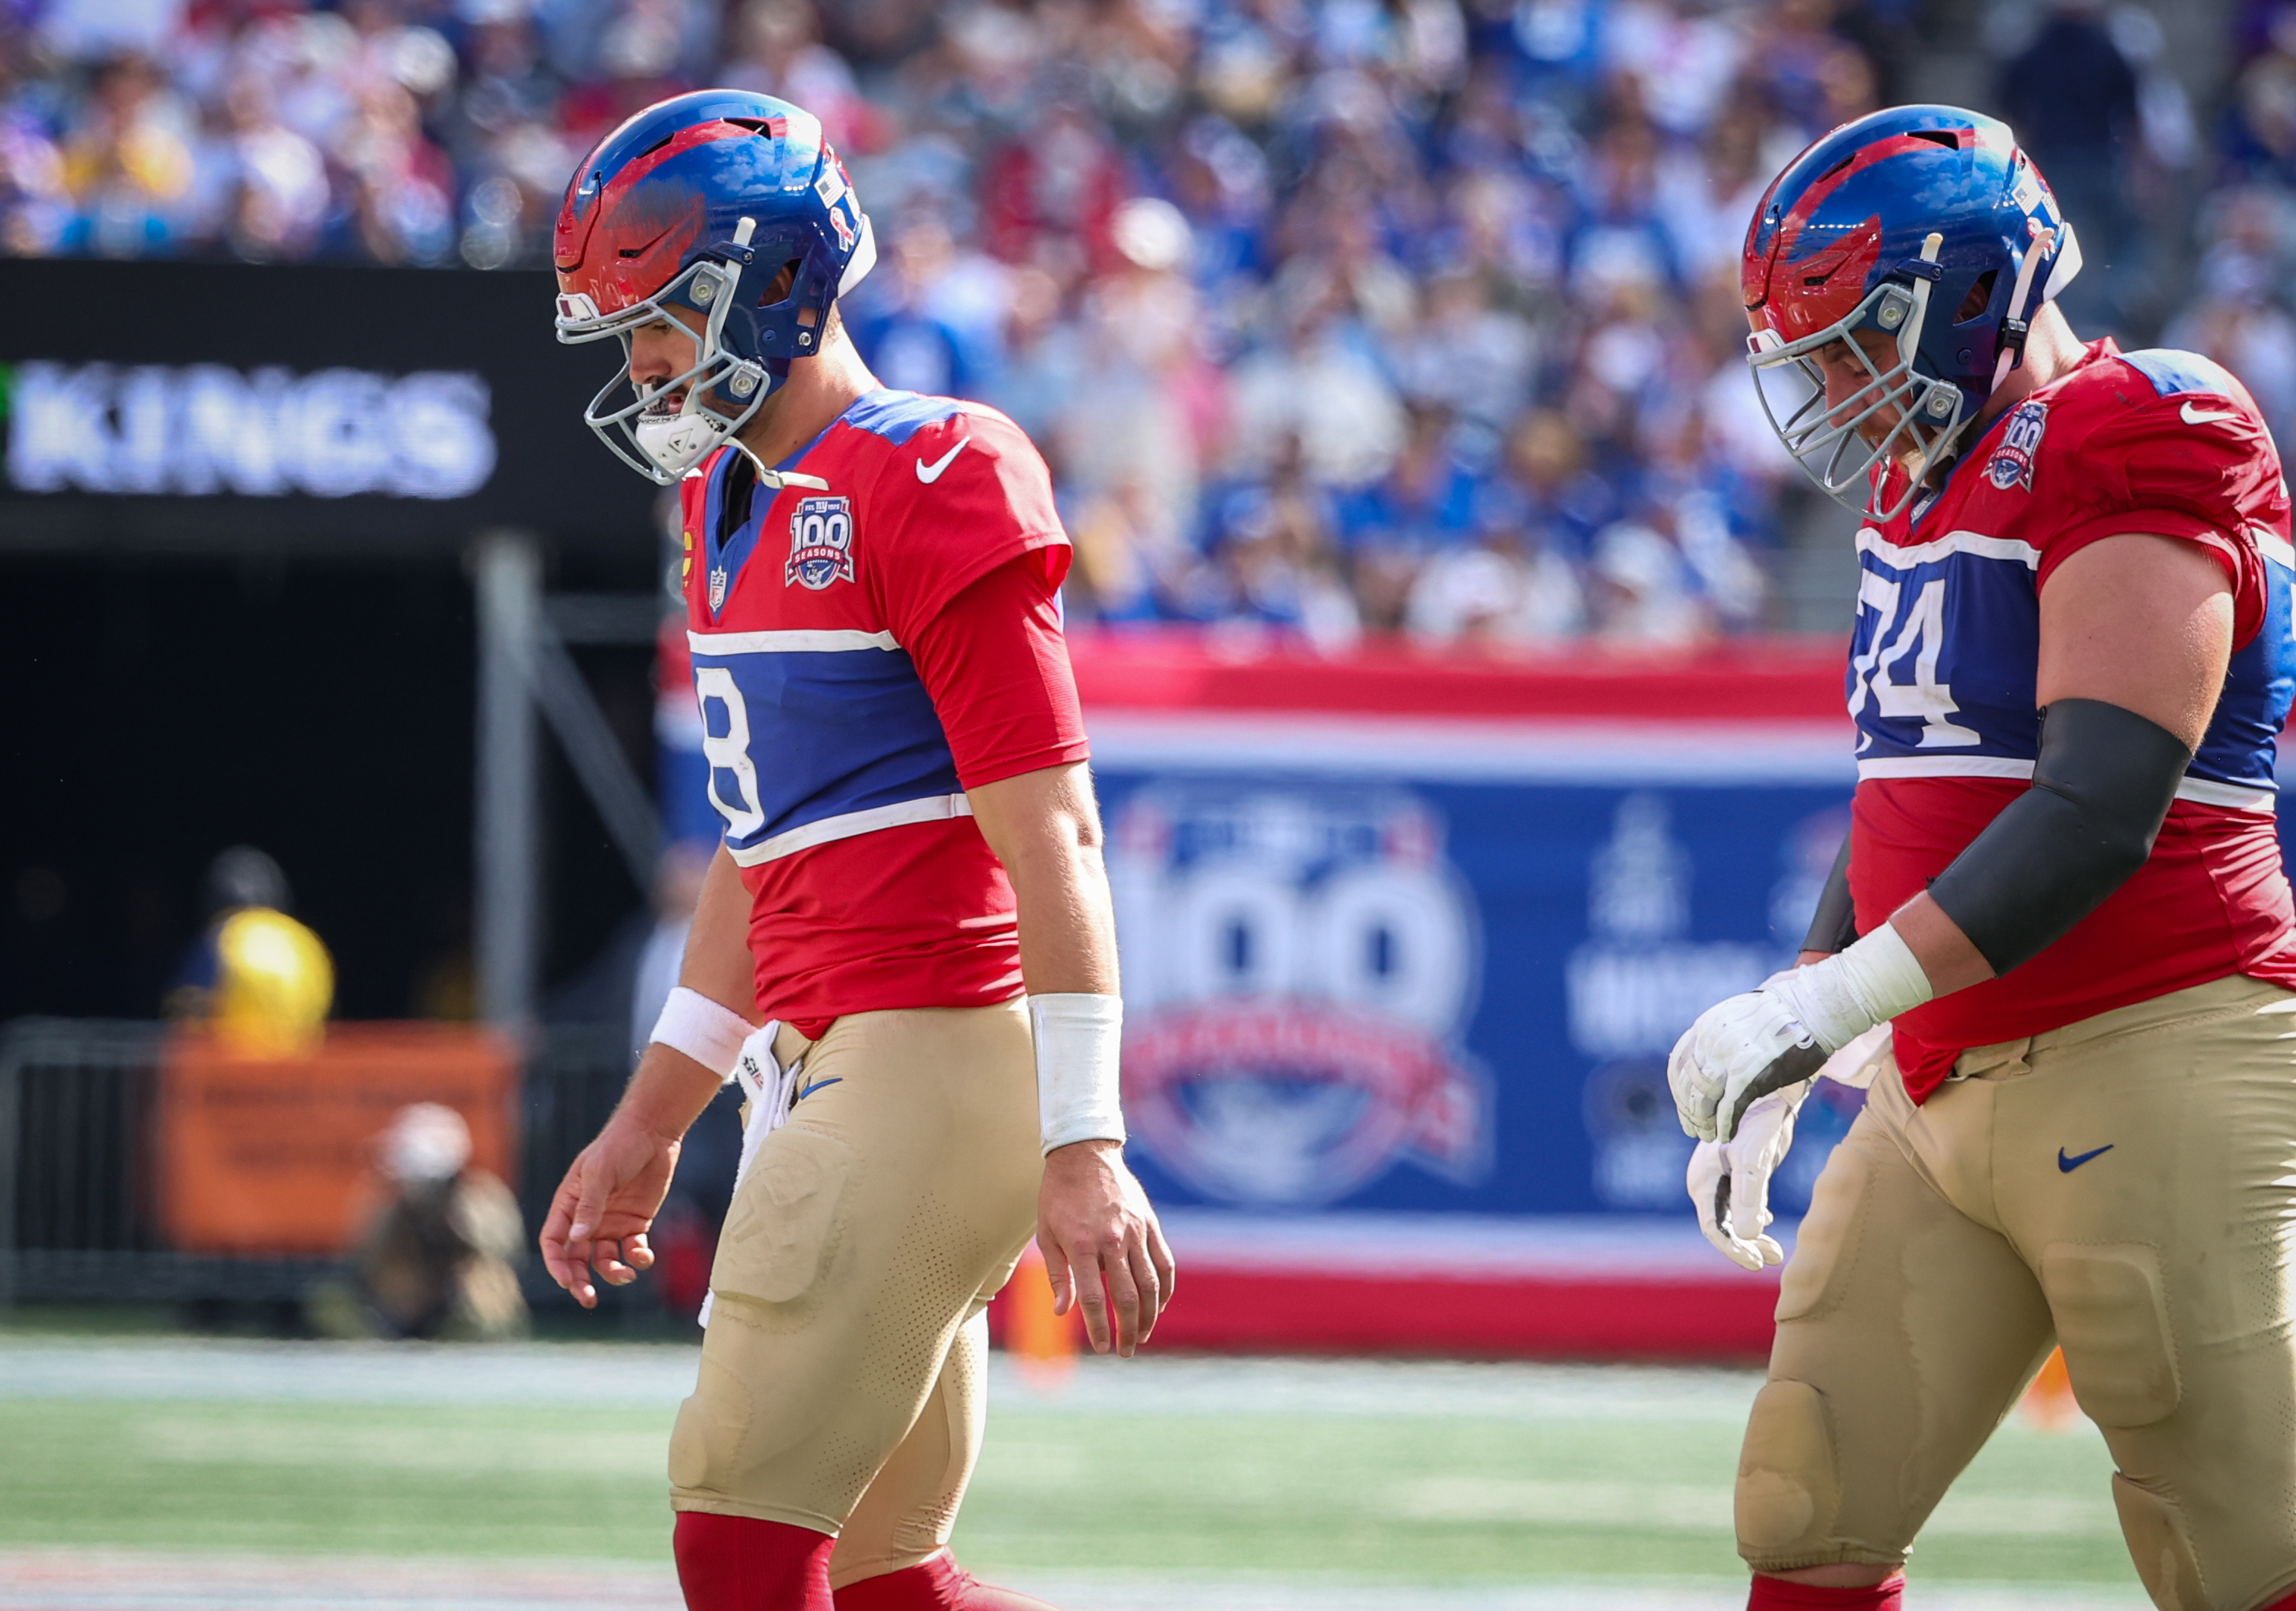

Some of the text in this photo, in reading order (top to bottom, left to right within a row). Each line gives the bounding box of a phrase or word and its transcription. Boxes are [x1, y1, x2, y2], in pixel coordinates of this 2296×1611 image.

[793, 514, 849, 553] 100
[795, 548, 841, 562] SEASONS
[1848, 568, 1981, 753] 74
[696, 668, 765, 839] 8
